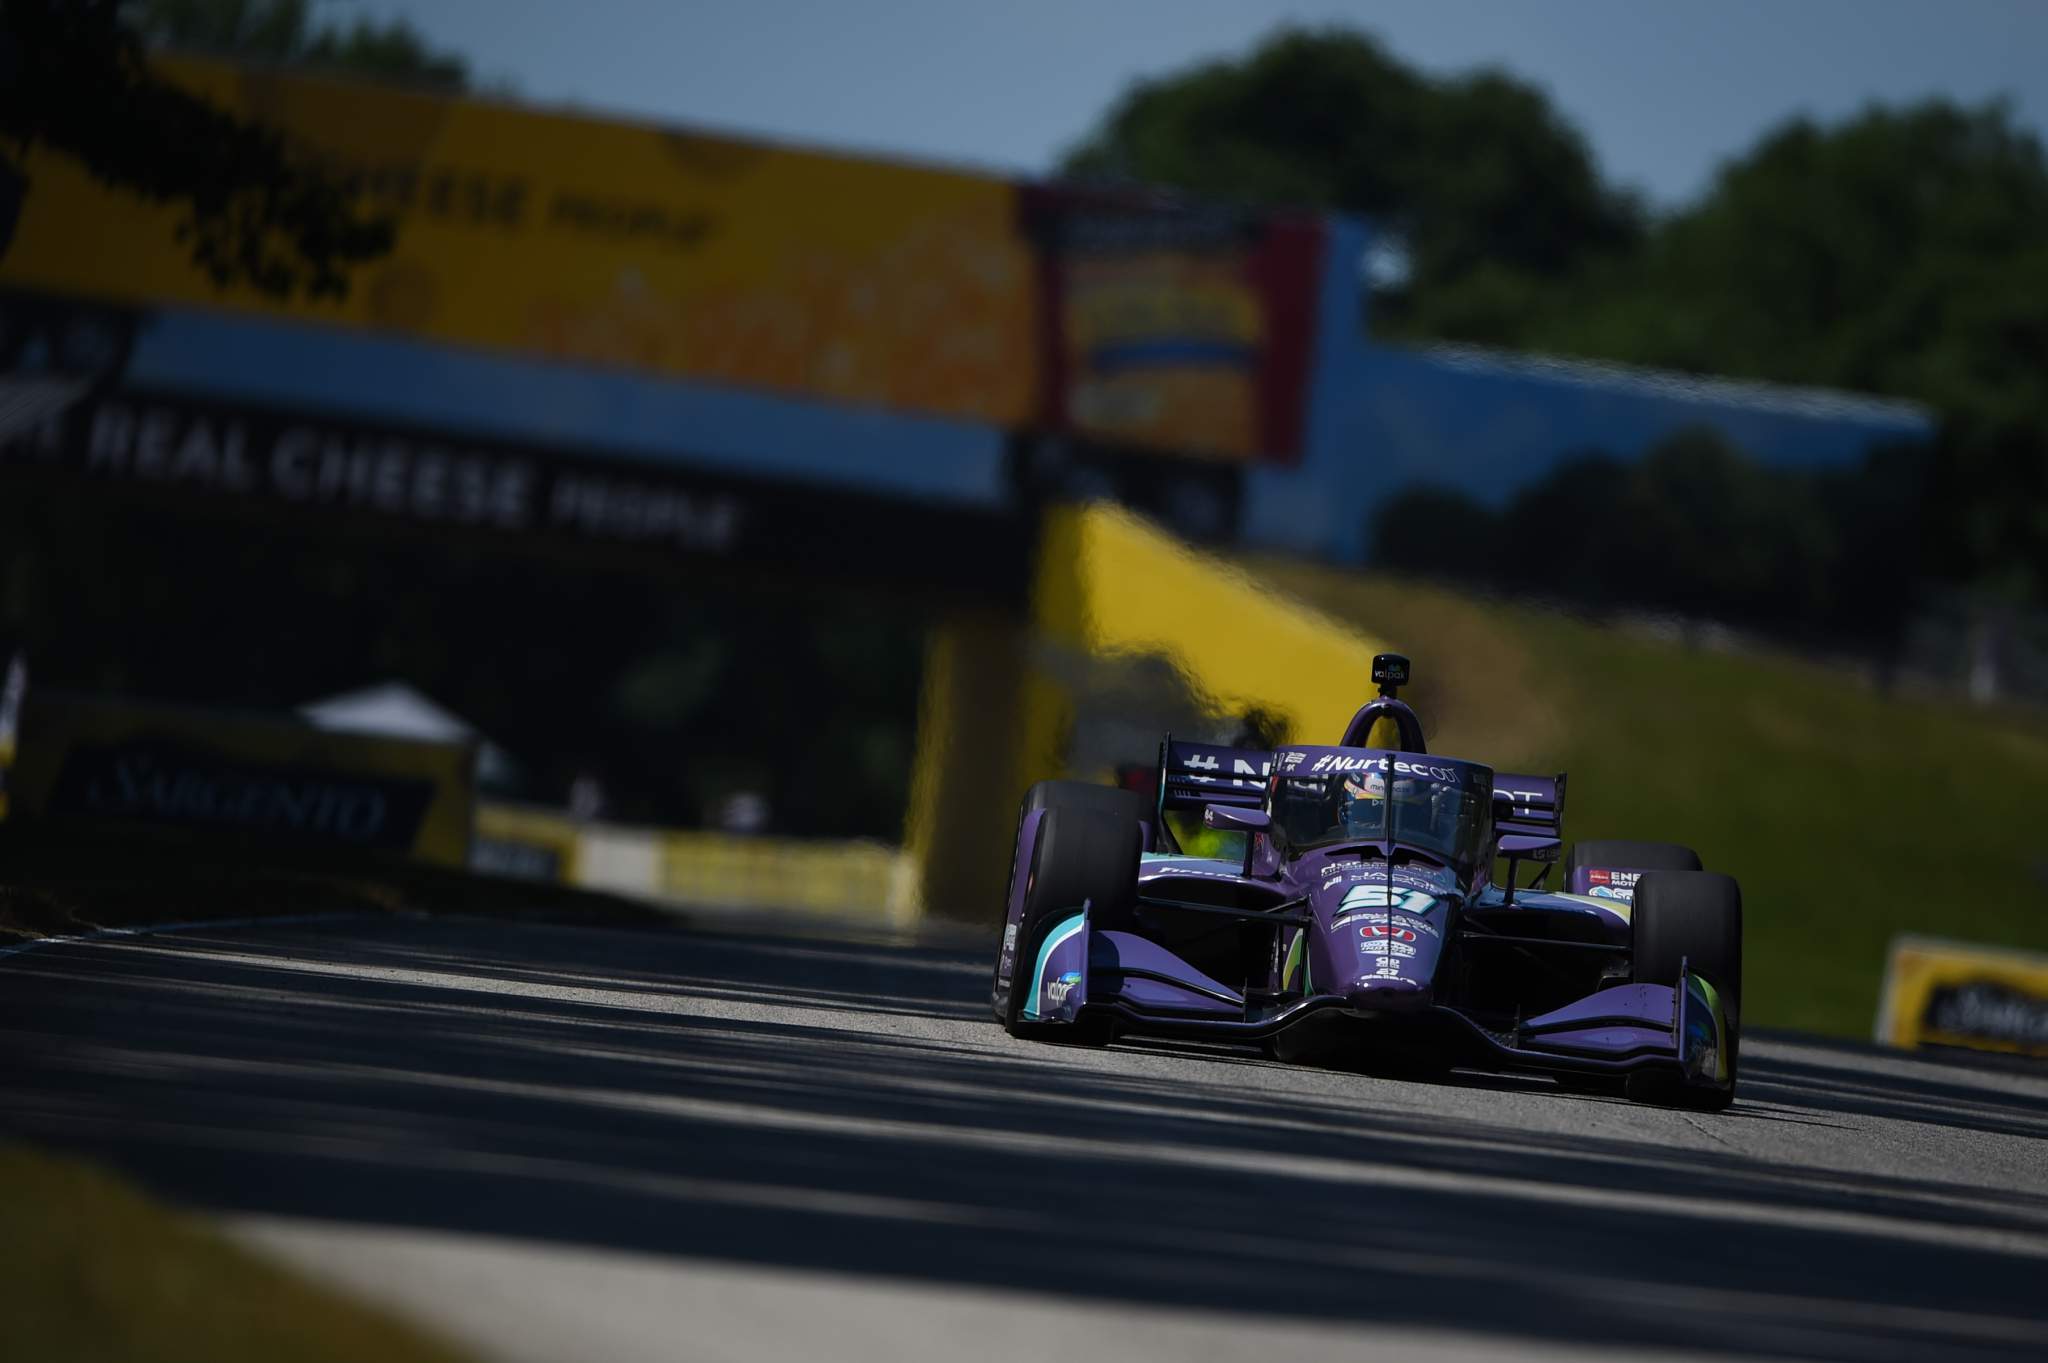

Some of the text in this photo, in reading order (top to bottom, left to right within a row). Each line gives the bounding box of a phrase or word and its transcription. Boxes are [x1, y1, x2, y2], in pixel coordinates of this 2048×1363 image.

[88, 401, 260, 490] REAL
[269, 420, 536, 528] CHEESE
[552, 470, 742, 551] PEOPLE
[1335, 884, 1440, 916] 51
